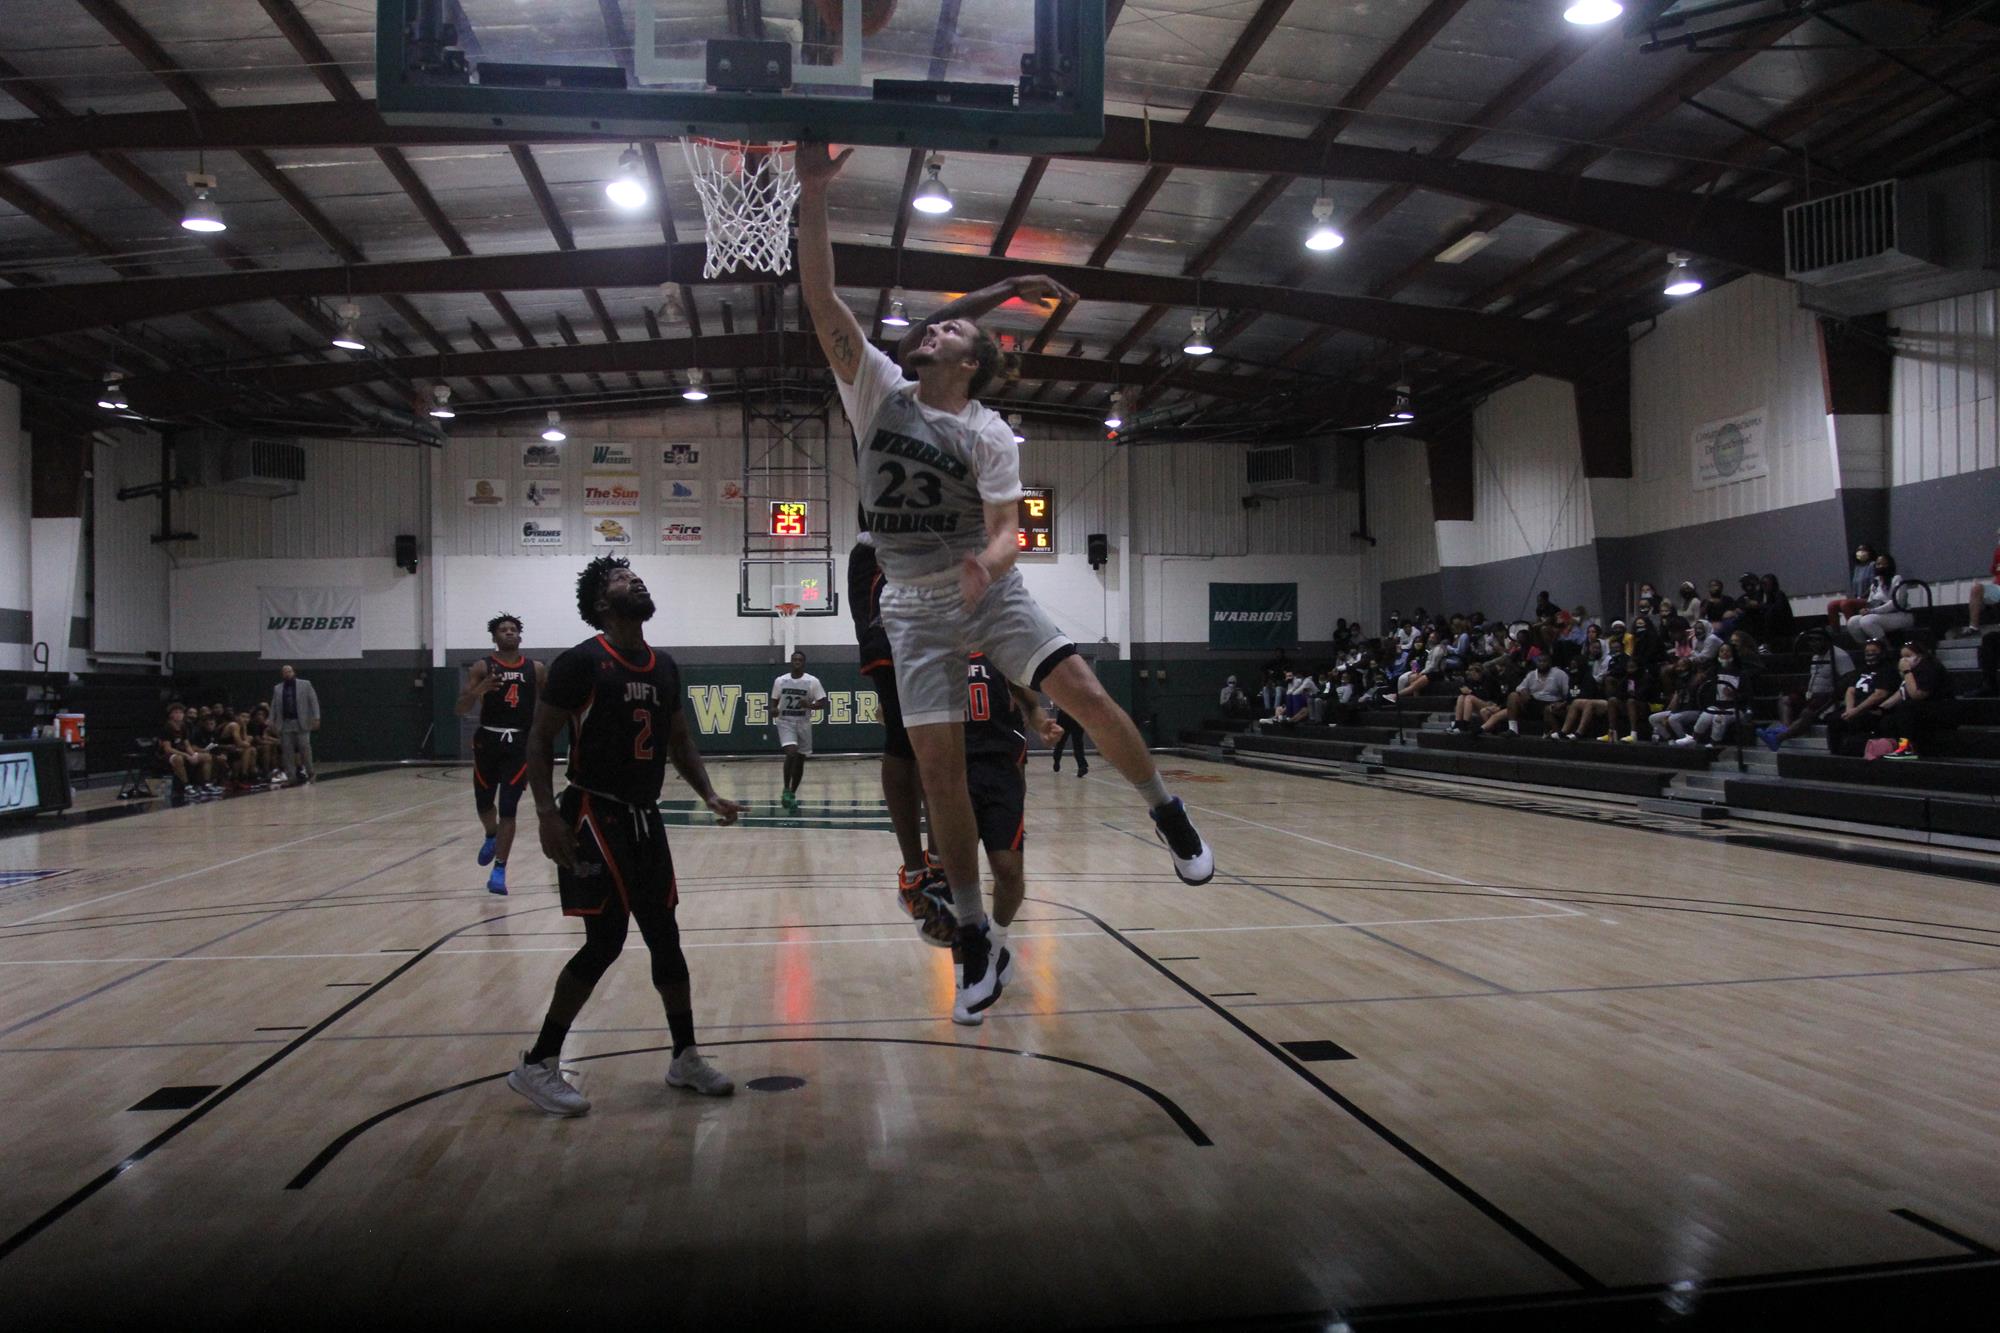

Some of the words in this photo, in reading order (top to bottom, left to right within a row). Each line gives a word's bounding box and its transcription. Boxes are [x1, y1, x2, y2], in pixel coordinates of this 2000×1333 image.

[585, 487, 610, 498] The
[611, 484, 639, 498] Sun
[874, 461, 942, 509] 23
[1023, 499, 1045, 517] 72
[665, 523, 702, 534] Fire
[776, 515, 801, 533] 25
[1037, 533, 1047, 547] 6
[267, 616, 356, 630] WEBBER
[1214, 611, 1293, 622] WARRIORS
[967, 664, 991, 680] FL
[504, 683, 520, 709] 4
[624, 682, 660, 706] JUFL
[688, 685, 880, 735] WEER
[632, 708, 654, 760] 2
